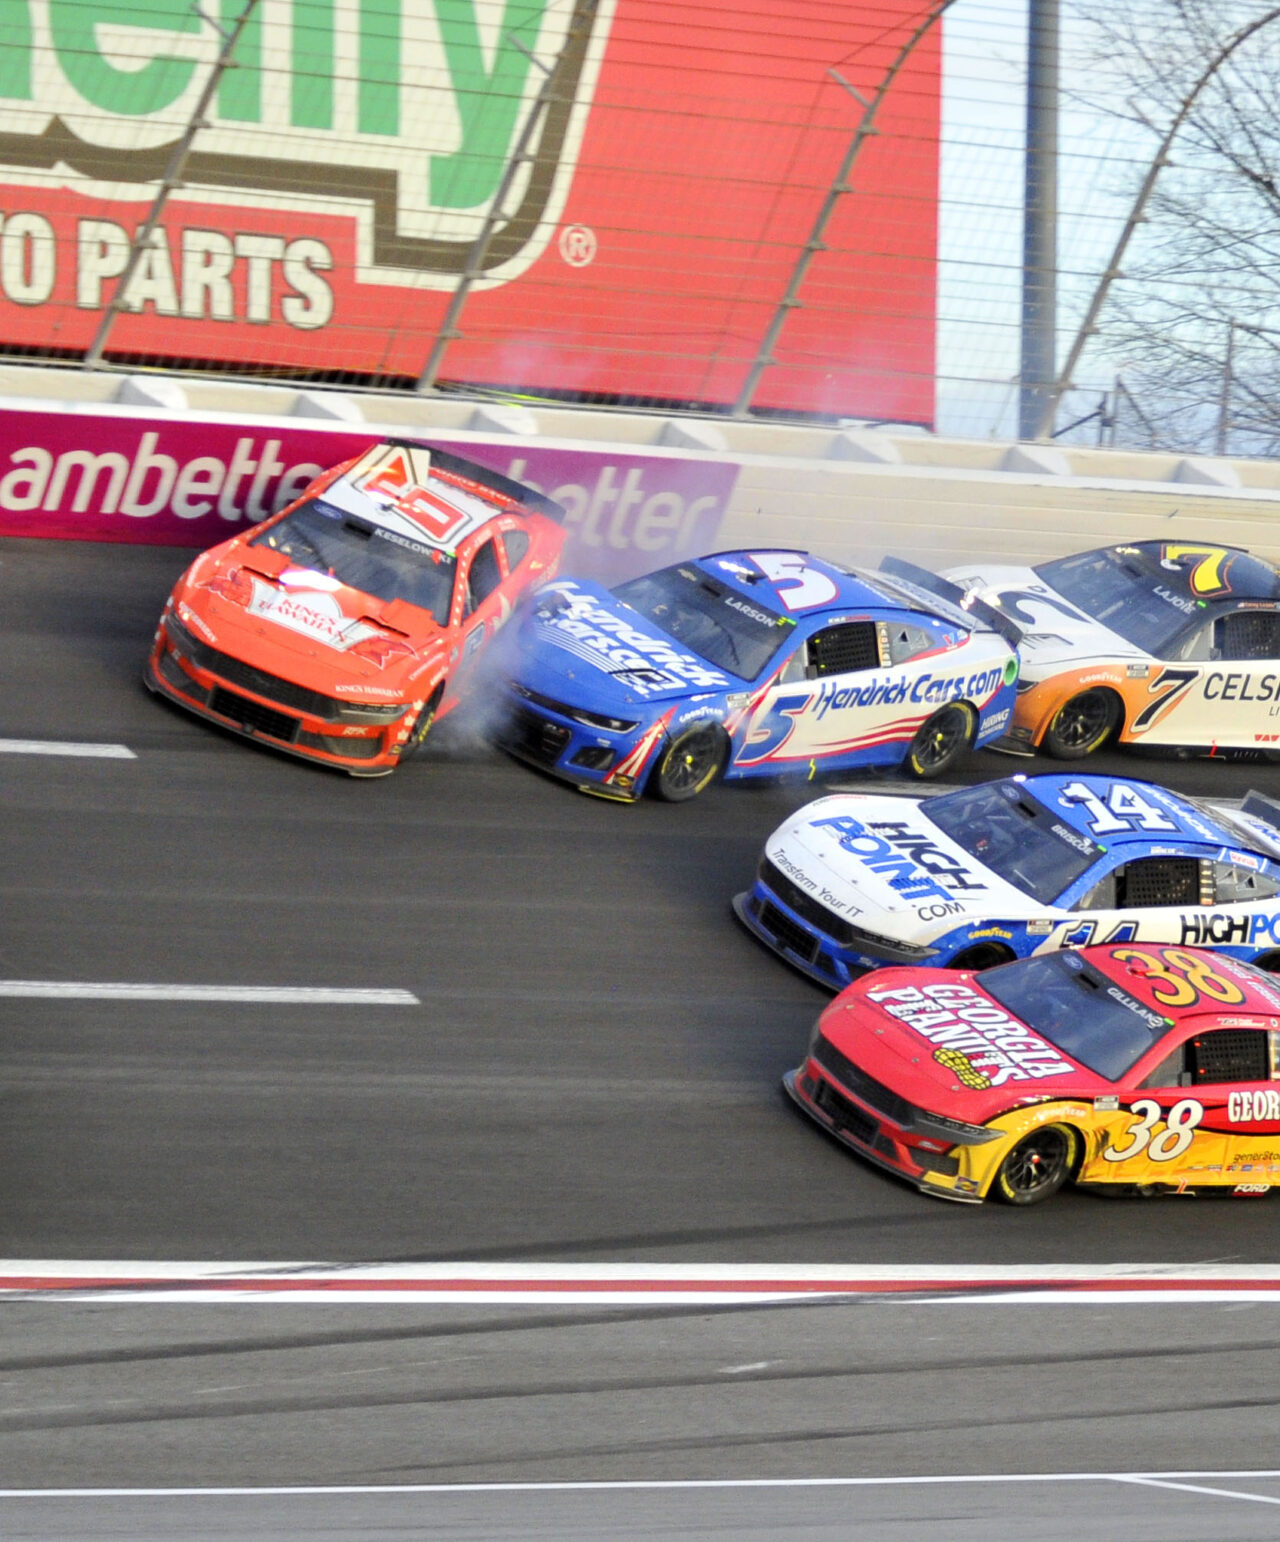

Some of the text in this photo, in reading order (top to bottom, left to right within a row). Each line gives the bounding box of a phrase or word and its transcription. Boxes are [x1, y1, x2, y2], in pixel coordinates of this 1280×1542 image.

[0, 211, 333, 330] O PARTS
[374, 527, 452, 564] KESELOWKI
[1164, 545, 1230, 594] 7
[748, 552, 840, 612] 5
[1152, 585, 1196, 615] LAJOIE
[723, 596, 778, 629] LARSON
[812, 666, 1003, 721] HendrickCars.com
[1133, 667, 1200, 729] 7
[733, 690, 816, 767] 5
[1059, 781, 1183, 837] 14
[808, 815, 956, 901] POINT
[866, 822, 989, 890] HIGH
[1050, 824, 1095, 857] BRISCOE
[772, 848, 864, 919] Transform Your IT
[1112, 948, 1246, 1007] 38
[866, 986, 1032, 1087] PEANUTS
[921, 984, 1077, 1079] GEORGIA
[1102, 1098, 1205, 1163] 38
[1234, 1183, 1270, 1193] FORD
